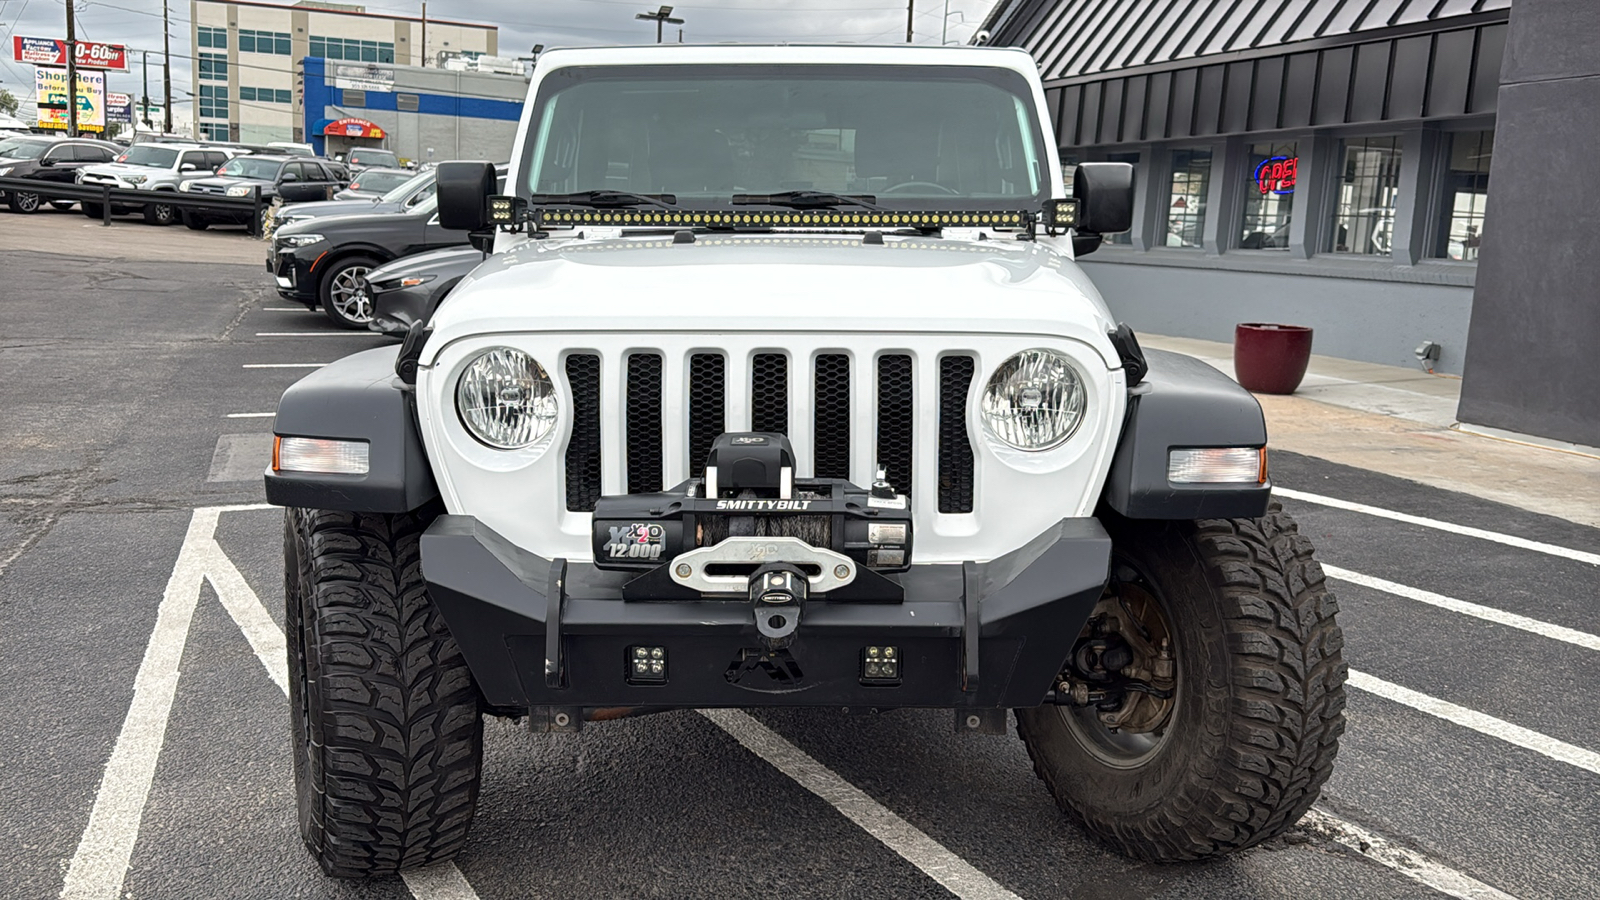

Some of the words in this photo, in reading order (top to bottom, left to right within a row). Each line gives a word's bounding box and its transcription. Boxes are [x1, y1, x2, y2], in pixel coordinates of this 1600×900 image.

[87, 58, 109, 66] Product
[37, 70, 67, 82] Shop
[38, 83, 65, 91] Before
[87, 87, 102, 95] Buy
[338, 118, 371, 127] ENTRANCE
[716, 500, 811, 510] SMITTYBILT
